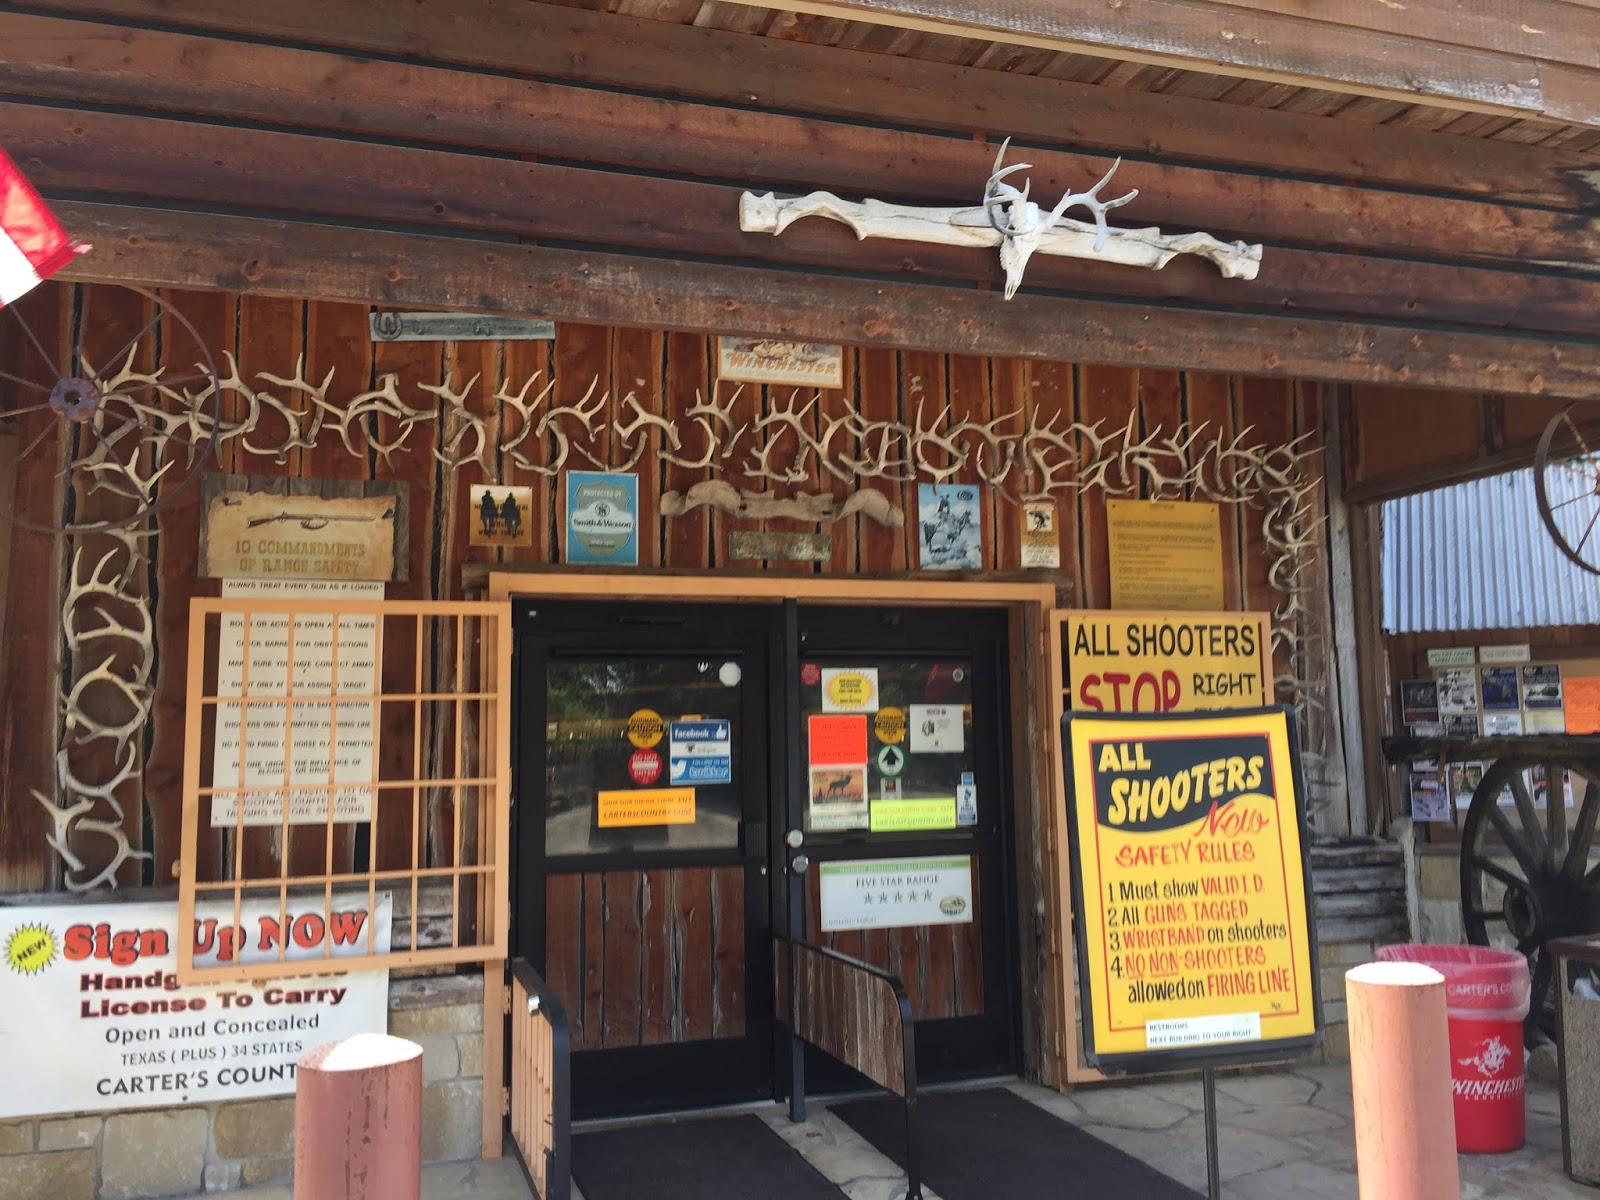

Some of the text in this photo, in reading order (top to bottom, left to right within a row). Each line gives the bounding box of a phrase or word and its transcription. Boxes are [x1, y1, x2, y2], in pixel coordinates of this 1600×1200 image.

[726, 352, 836, 374] WINCHESTER
[235, 540, 365, 557] 10 COMMANDMENTS
[240, 559, 359, 574] OF RANGE SAFETY
[285, 582, 308, 590] EVERY
[256, 620, 267, 628] OR
[355, 621, 375, 629] TIMES
[265, 640, 288, 648] BARRE
[1073, 623, 1255, 656] ALL SHOOTERS
[1079, 669, 1256, 712] STOP RIGHT
[674, 728, 709, 739] facebook
[1099, 742, 1151, 773] ALL
[1108, 755, 1265, 825] SHOOTERS
[1116, 840, 1255, 867] SAFETY RULES
[856, 874, 939, 888] FIVE STAR RANGE
[1120, 880, 1158, 901] Must
[1163, 878, 1199, 898] show
[1201, 875, 1239, 896] VALID
[1122, 907, 1139, 926] All
[1144, 901, 1187, 924] GUNS
[1192, 899, 1248, 921] TAGGED
[63, 910, 368, 966] Sign Up NOW
[1122, 923, 1205, 950] WRISTBAND
[1207, 927, 1224, 944] on
[1227, 918, 1287, 943] shooters
[16, 937, 48, 963] NEW
[1125, 953, 1145, 978] NO
[1128, 966, 1291, 1004] allowed on FIRING LINE
[81, 986, 348, 1019] License To Carry
[105, 1013, 320, 1047] Open and Concealed
[1150, 1022, 1188, 1031] RESTROOMS
[1169, 1035, 1200, 1043] BUILDING
[1213, 1031, 1230, 1039] YOUR
[121, 1050, 166, 1066] TEXAS
[181, 1047, 217, 1063] PLUS
[232, 1045, 248, 1058] 34
[252, 1040, 303, 1055] STATES
[96, 1062, 297, 1097] CARTER'S COUNT
[1451, 1077, 1524, 1095] WINCHEST
